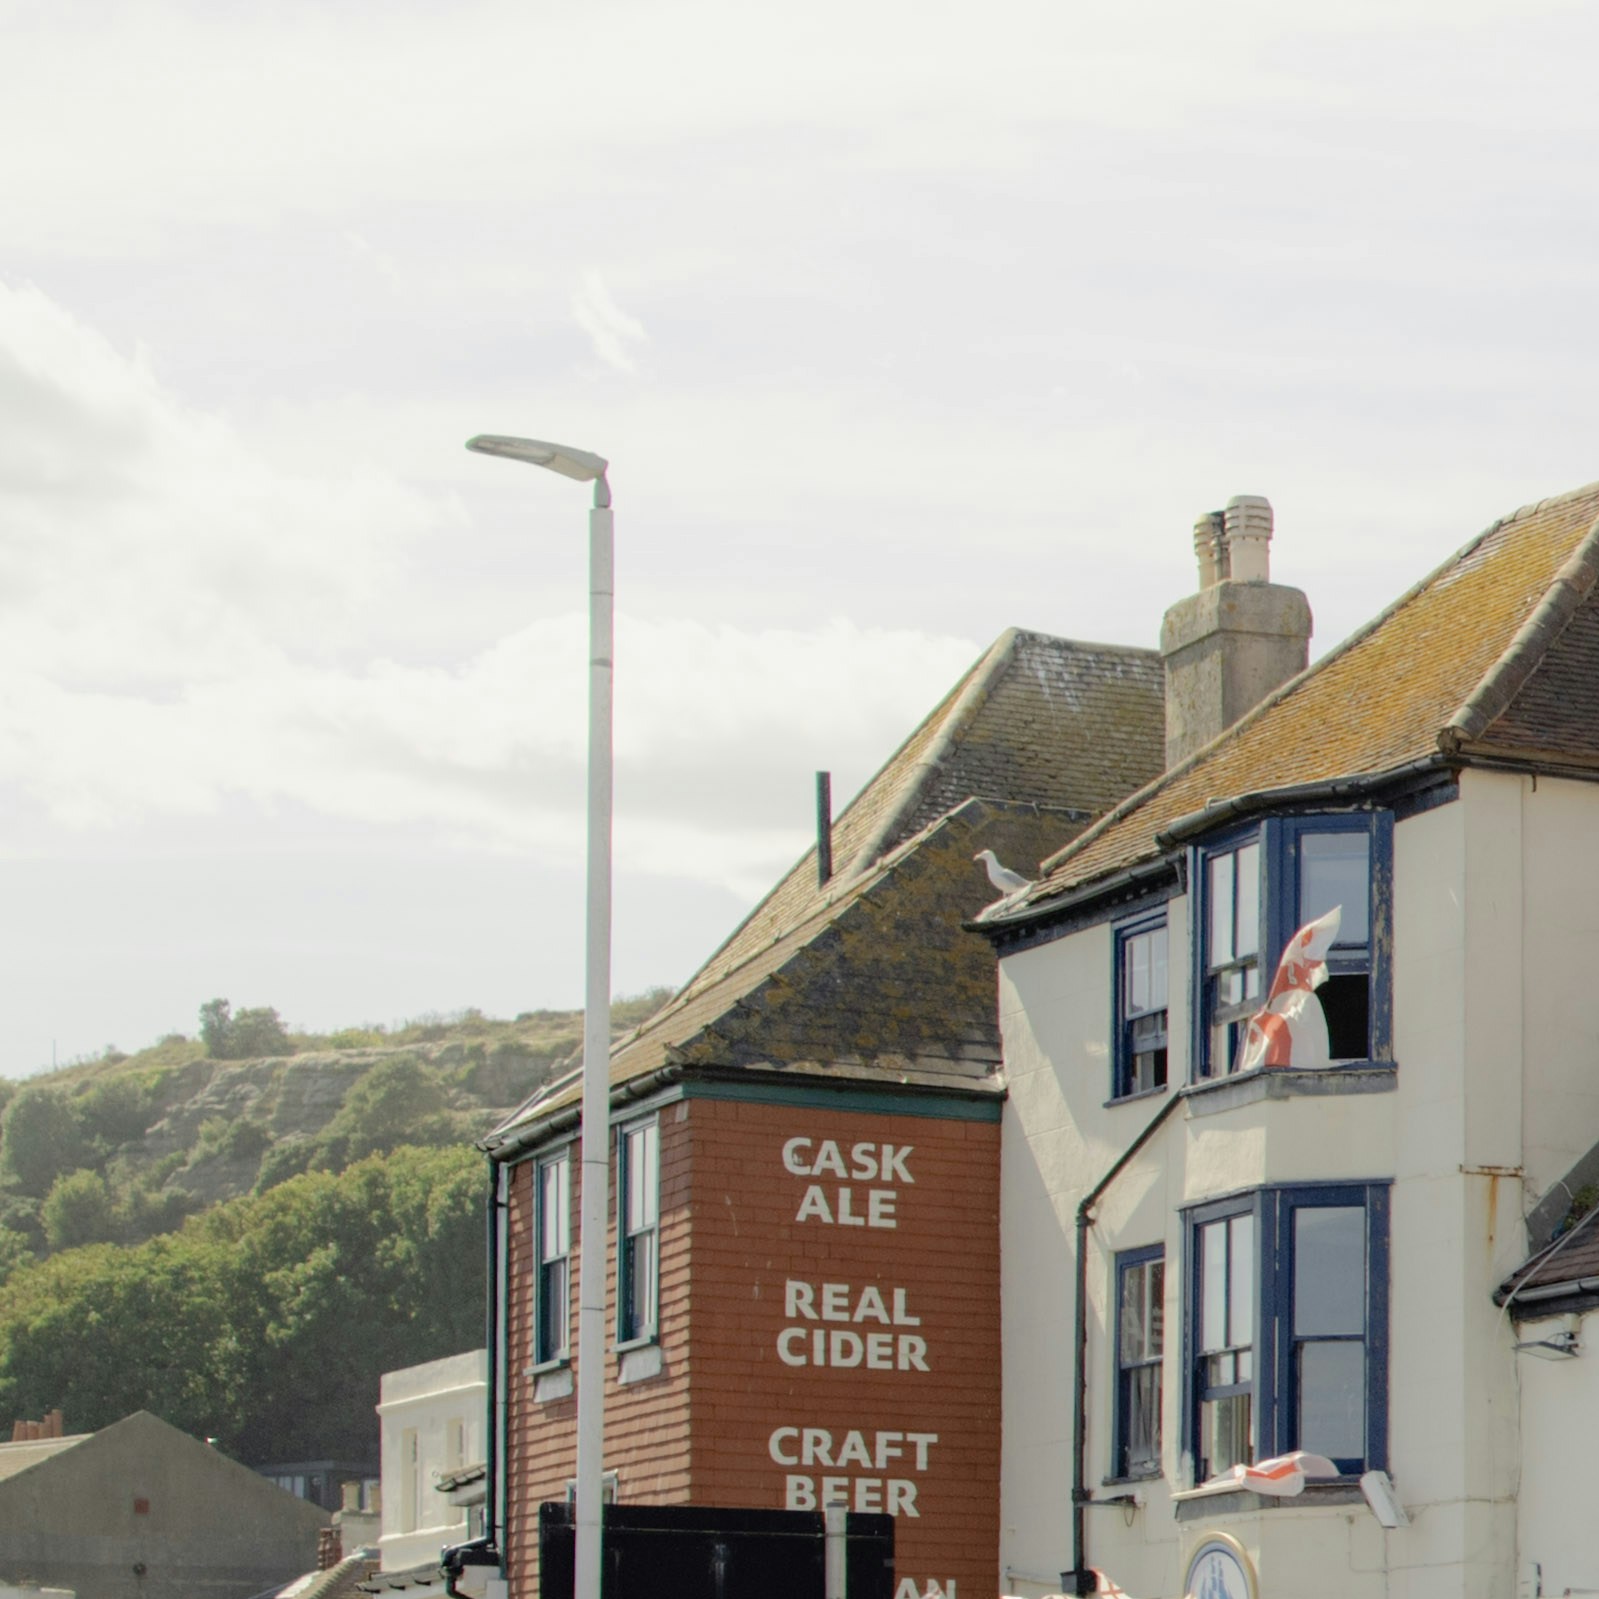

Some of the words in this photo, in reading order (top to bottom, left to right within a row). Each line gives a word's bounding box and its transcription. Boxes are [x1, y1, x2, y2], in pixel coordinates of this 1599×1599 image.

[782, 1137, 915, 1183] CASK
[795, 1185, 897, 1228] ALE
[785, 1279, 920, 1326] REAL
[777, 1327, 930, 1371] CIDER
[768, 1426, 938, 1471] CRAFT
[785, 1475, 920, 1518] BEER
